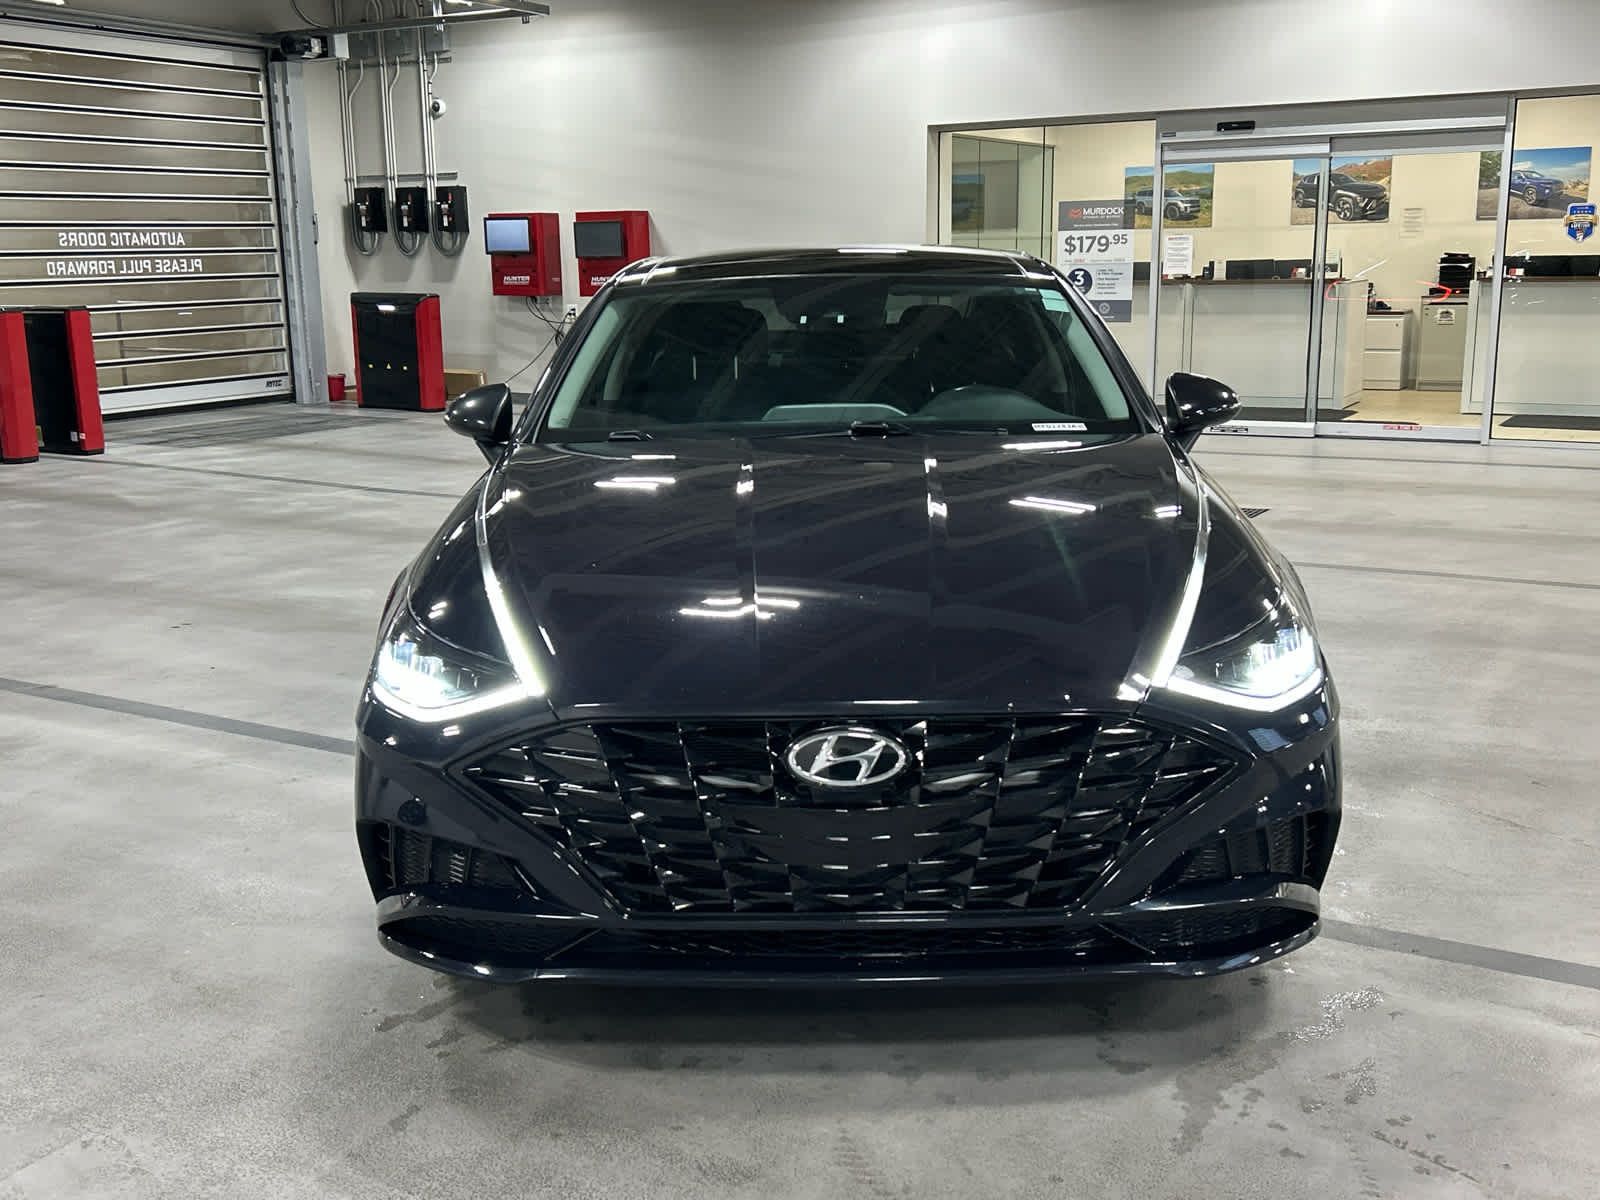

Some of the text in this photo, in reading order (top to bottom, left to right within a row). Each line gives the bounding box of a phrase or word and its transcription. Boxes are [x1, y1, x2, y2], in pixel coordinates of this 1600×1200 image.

[1083, 206, 1124, 215] MURDOCK
[1064, 233, 1128, 256] $179.95
[1074, 271, 1085, 286] 3
